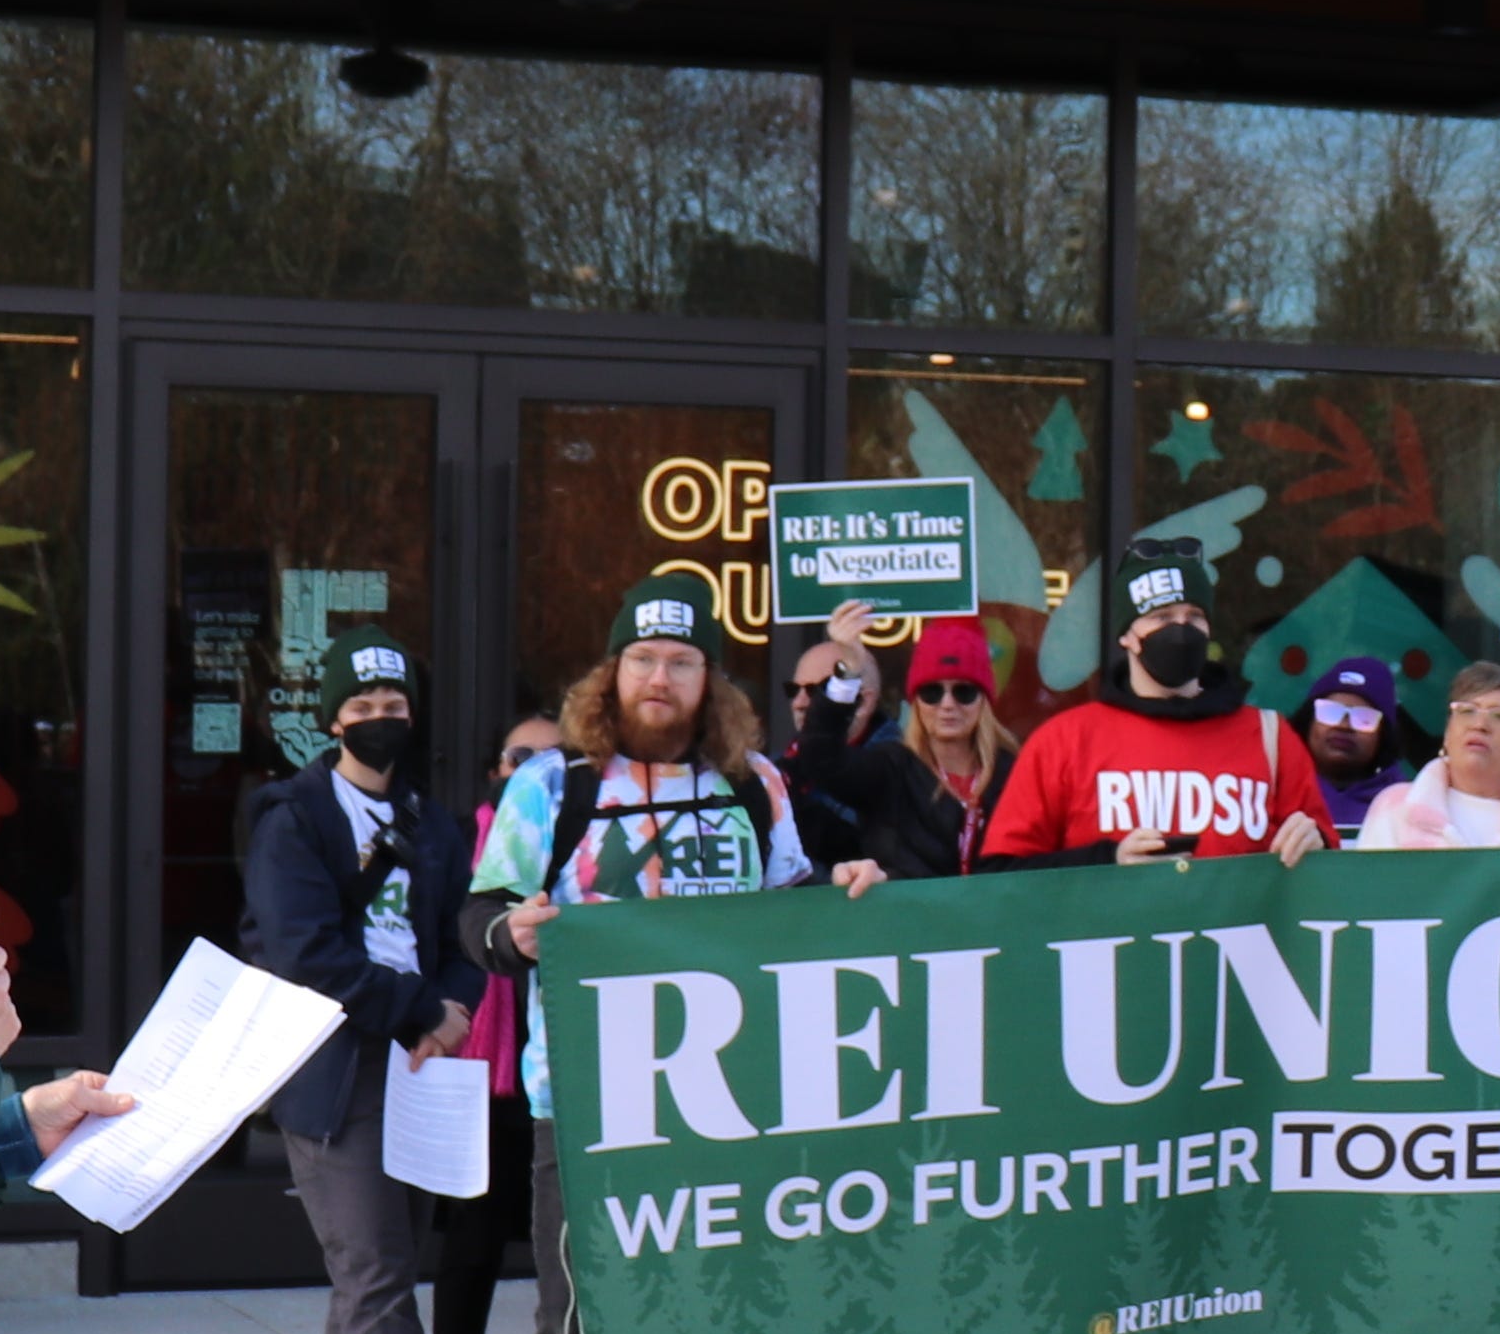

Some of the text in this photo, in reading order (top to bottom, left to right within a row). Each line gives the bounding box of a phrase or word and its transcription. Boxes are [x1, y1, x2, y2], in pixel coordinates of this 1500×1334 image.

[642, 457, 770, 541] OP
[783, 510, 964, 543] REI: It's Time
[790, 547, 956, 580] to Negotiate.
[1129, 568, 1183, 606] REI
[635, 599, 694, 629] REI
[352, 647, 406, 674] REI
[269, 688, 321, 706] Outsi
[1097, 771, 1268, 839] RWDSU
[579, 948, 1000, 1154] REI
[605, 1181, 743, 1259] WE
[765, 1169, 888, 1240] GO
[914, 1126, 1259, 1225] FURTHER
